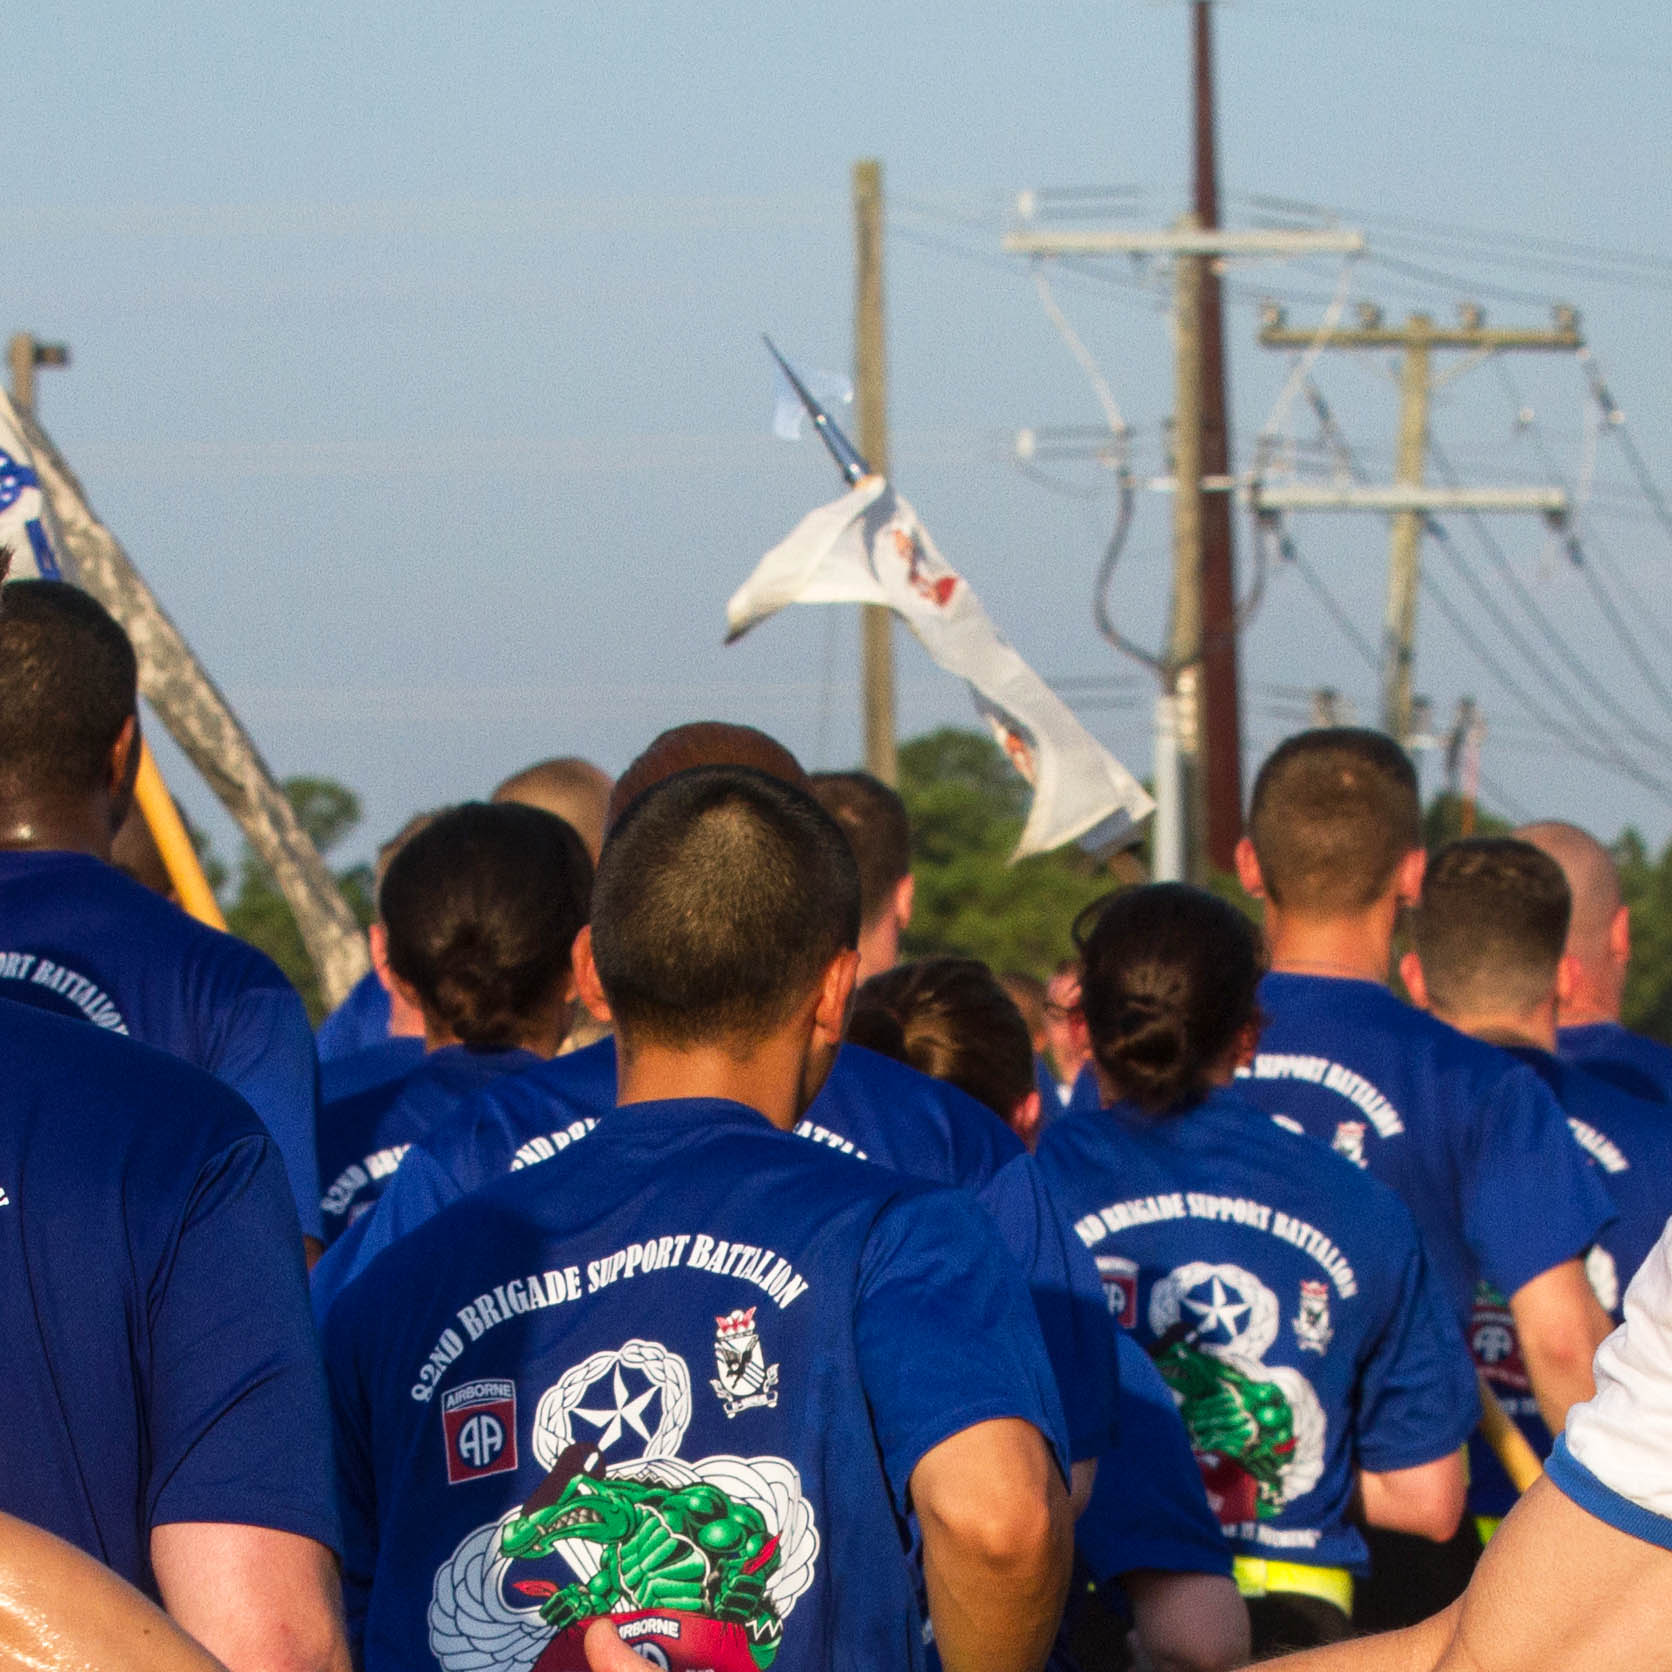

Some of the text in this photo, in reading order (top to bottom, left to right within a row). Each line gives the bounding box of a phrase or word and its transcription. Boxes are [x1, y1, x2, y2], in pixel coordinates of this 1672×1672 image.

[1186, 1191, 1272, 1232] SUPPORT
[1272, 1210, 1358, 1300] BATTALION
[456, 1266, 583, 1344] BRIGADE
[587, 1233, 692, 1295] SUPPORT
[685, 1233, 810, 1310] BATTALION
[444, 1383, 514, 1409] AIRBORNE
[458, 1414, 504, 1469] AA
